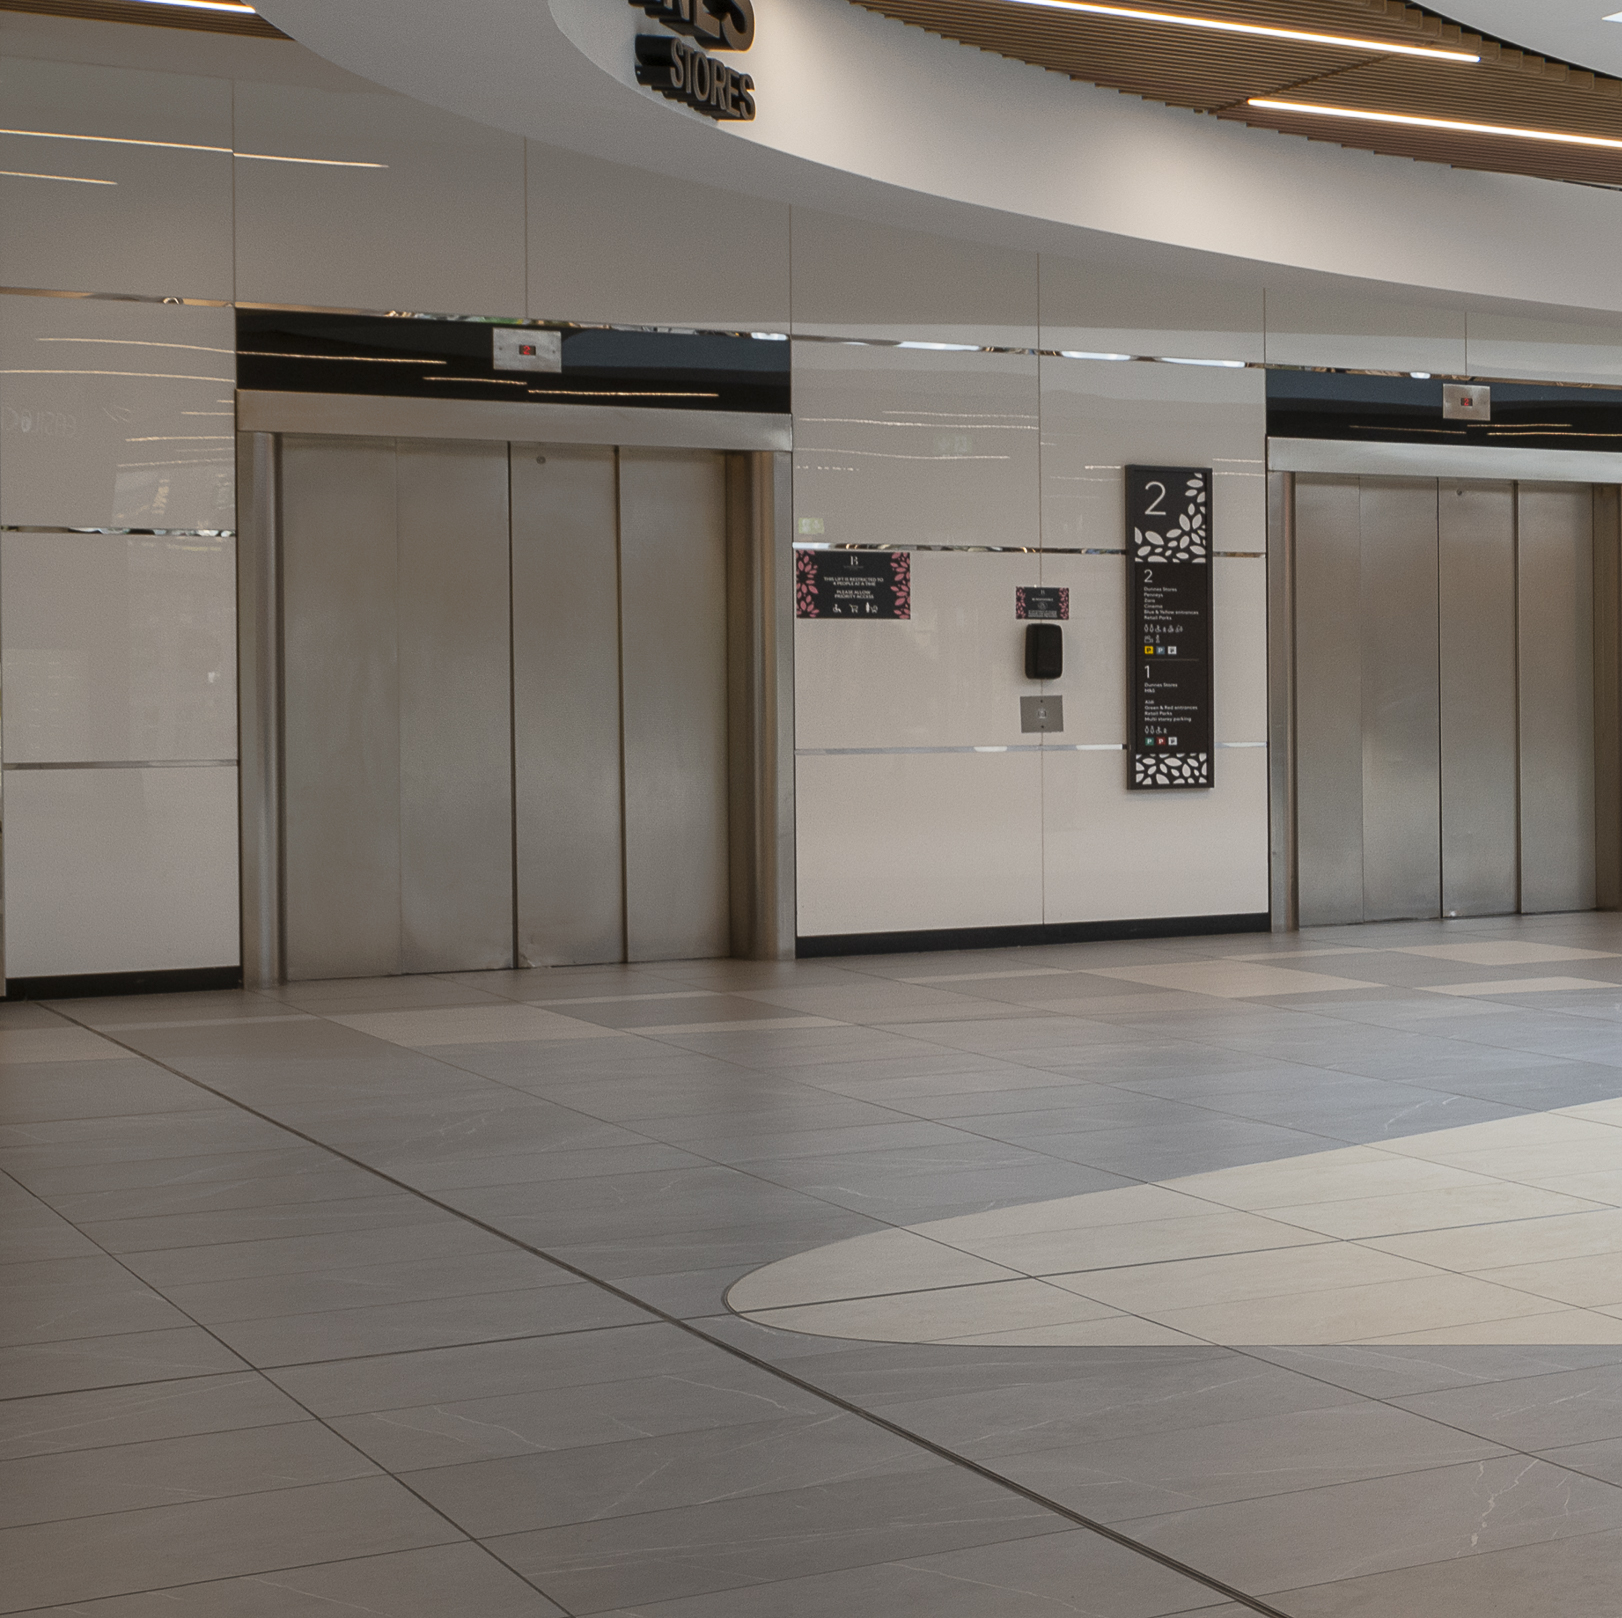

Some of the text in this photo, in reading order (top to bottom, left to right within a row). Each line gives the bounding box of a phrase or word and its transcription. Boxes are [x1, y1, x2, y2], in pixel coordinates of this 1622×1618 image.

[669, 36, 757, 122] STORES
[523, 345, 531, 355] 2
[1464, 397, 1469, 406] 2
[1144, 481, 1167, 516] 2
[1144, 568, 1153, 583] 2
[1144, 665, 1150, 679] 1
